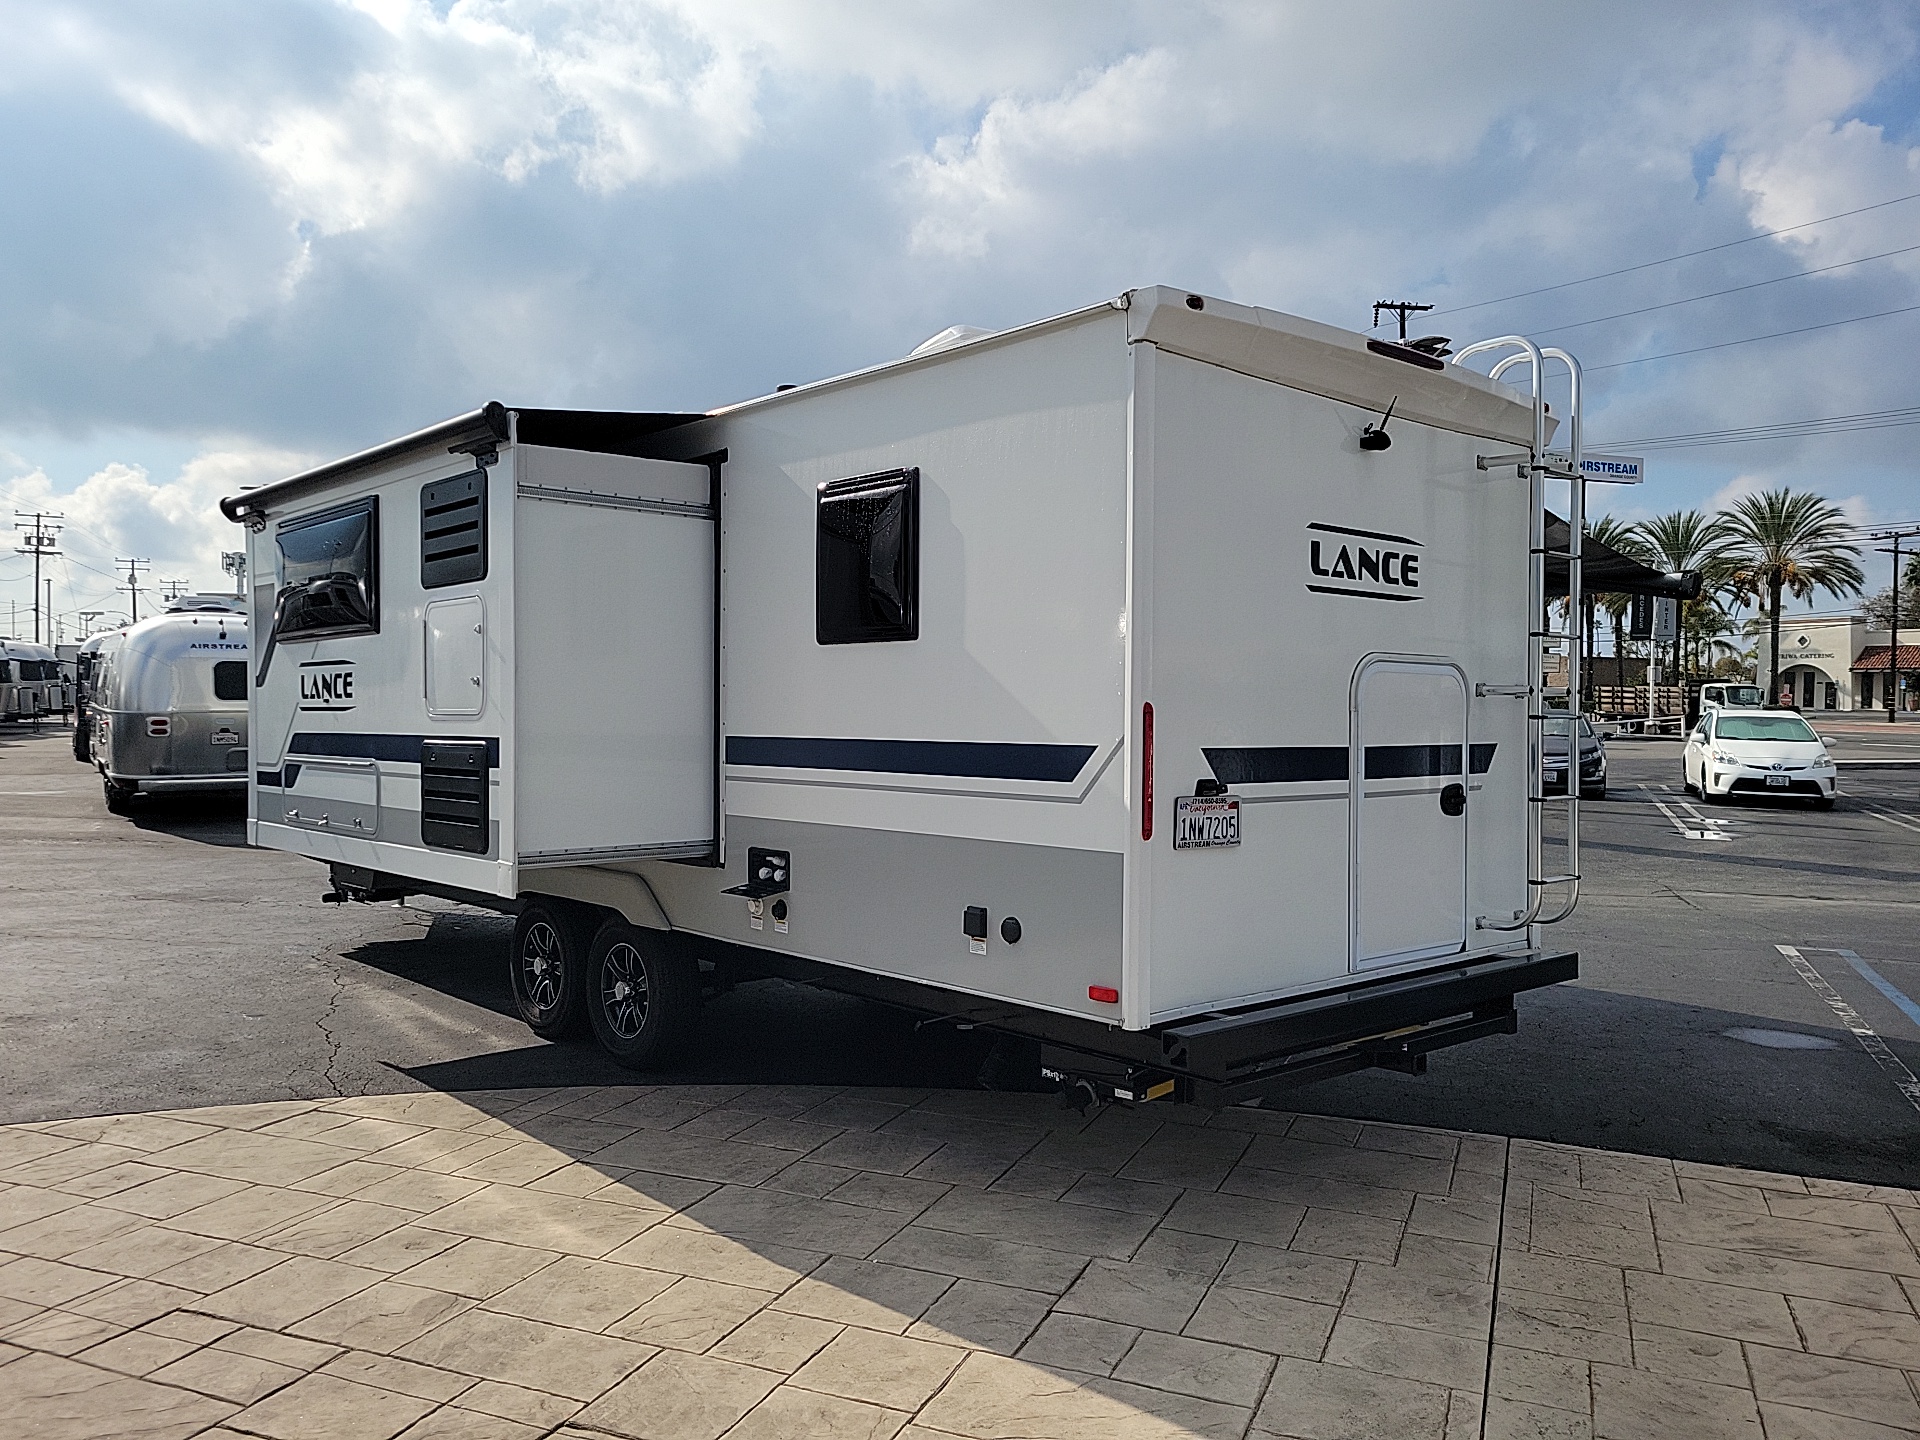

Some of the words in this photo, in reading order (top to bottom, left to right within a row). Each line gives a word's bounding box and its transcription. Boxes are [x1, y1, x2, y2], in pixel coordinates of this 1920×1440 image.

[1581, 461, 1638, 475] IRSTREAM
[1310, 540, 1419, 588] LANCE
[300, 672, 353, 700] LANCE
[1181, 816, 1236, 841] 1NW7205
